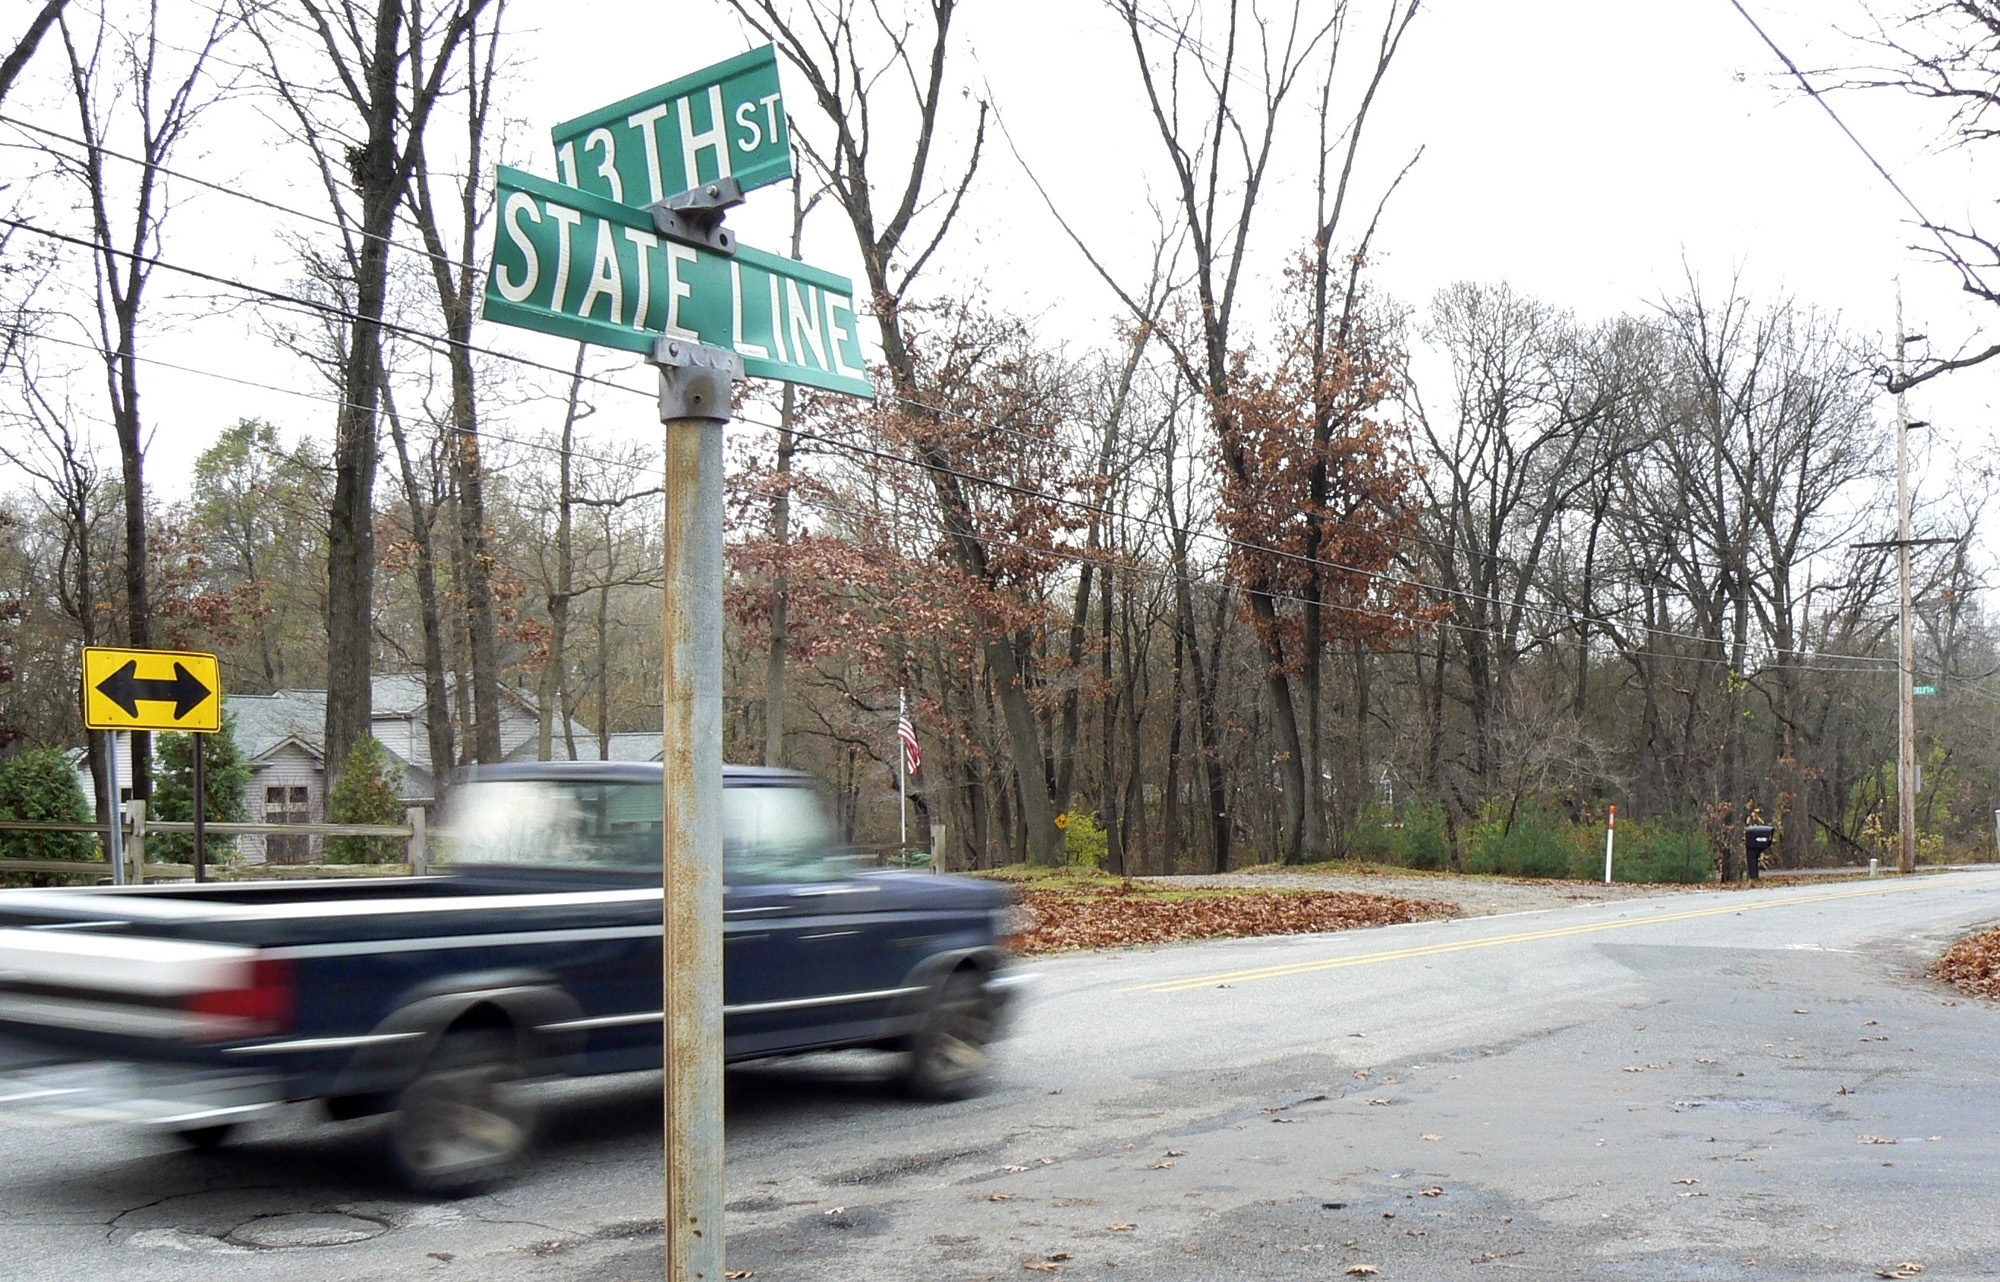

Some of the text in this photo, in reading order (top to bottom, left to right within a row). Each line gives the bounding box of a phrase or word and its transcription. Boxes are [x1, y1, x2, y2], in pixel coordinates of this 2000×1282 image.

[558, 83, 780, 206] 13TH ST
[495, 191, 866, 380] STATE LINE
